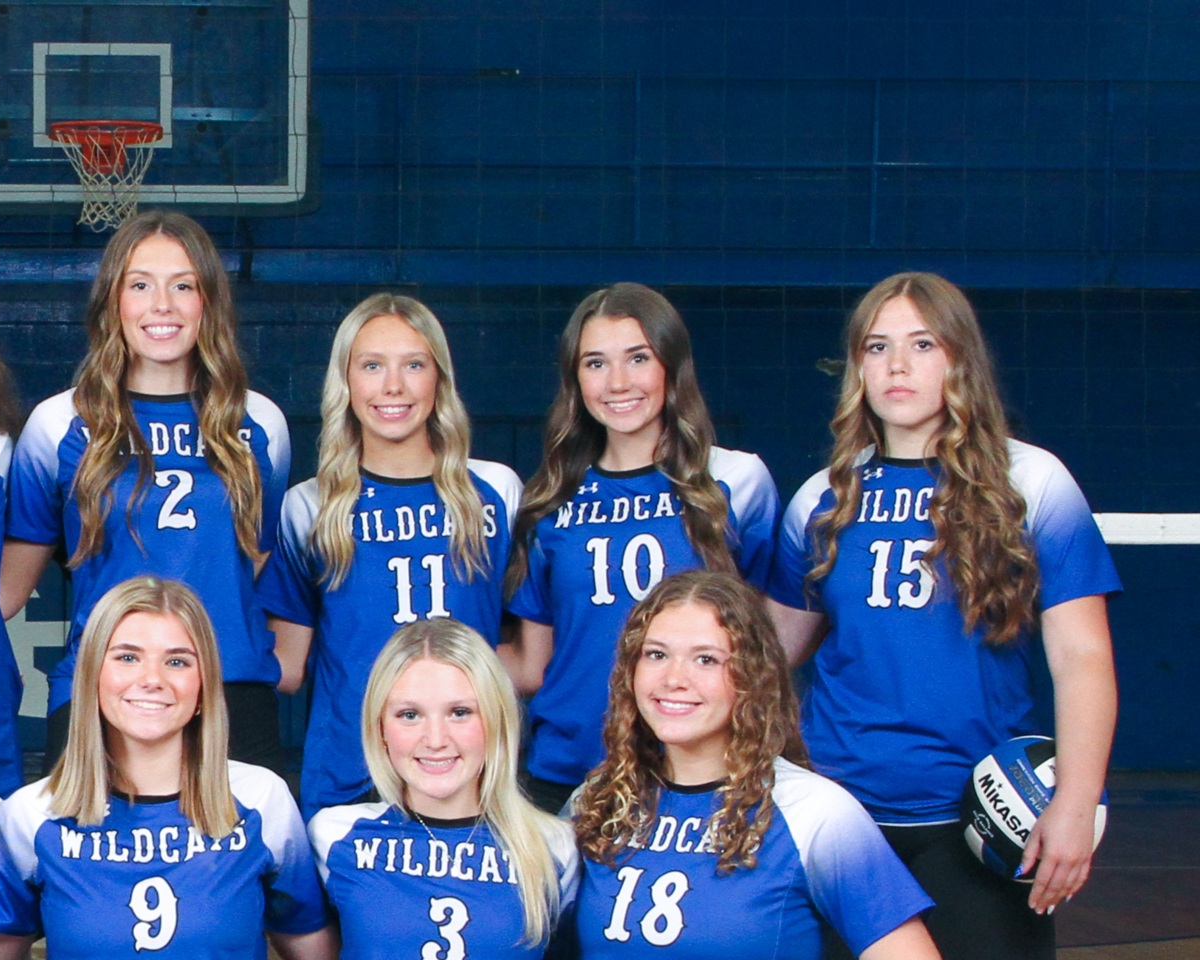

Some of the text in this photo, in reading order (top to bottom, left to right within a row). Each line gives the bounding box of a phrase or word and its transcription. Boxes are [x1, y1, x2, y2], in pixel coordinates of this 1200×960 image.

[154, 469, 197, 530] 2
[348, 504, 498, 543] ILDCS
[554, 492, 685, 528] WILDCA
[857, 487, 935, 523] ILDC
[388, 554, 451, 624] 11
[586, 533, 666, 605] 10
[866, 539, 938, 609] 15
[354, 838, 518, 884] WILDCAT
[128, 876, 178, 952] 9
[603, 866, 690, 946] 18
